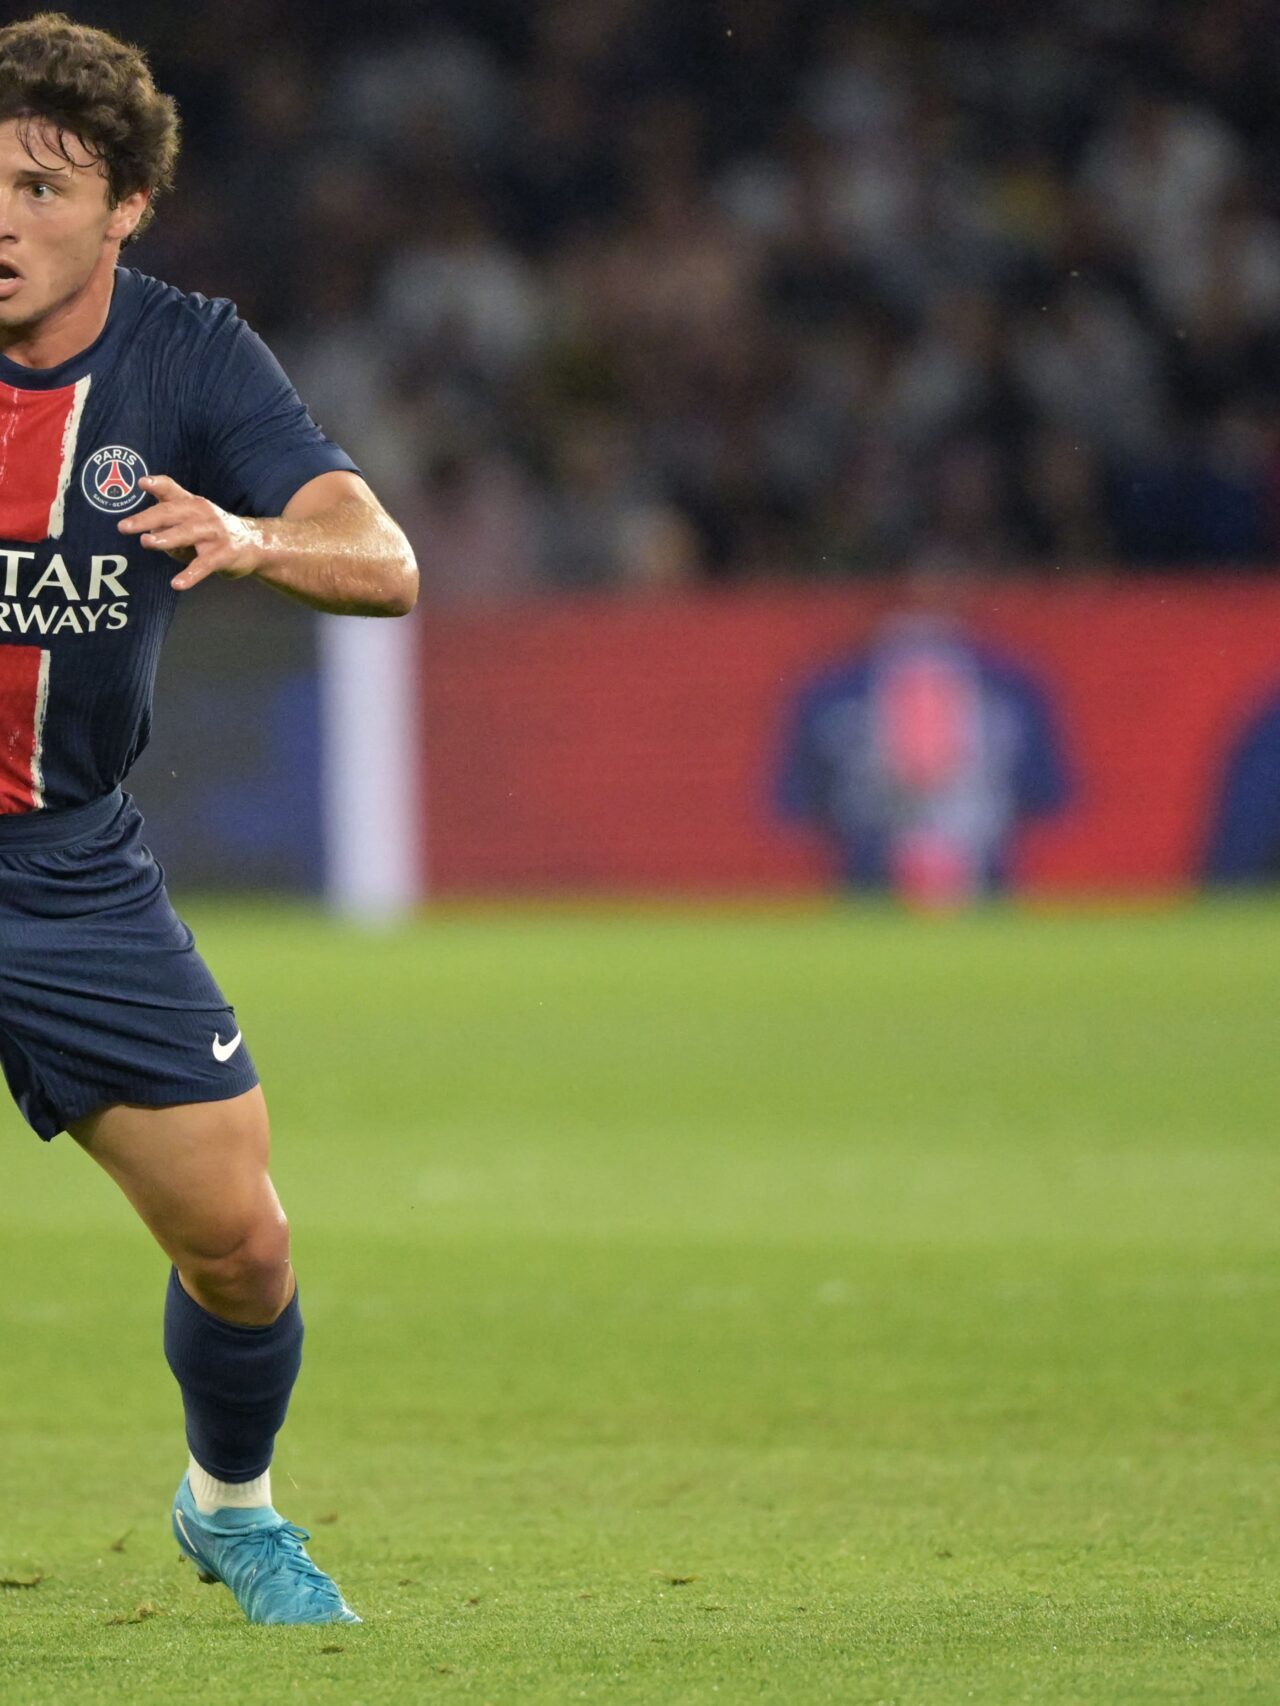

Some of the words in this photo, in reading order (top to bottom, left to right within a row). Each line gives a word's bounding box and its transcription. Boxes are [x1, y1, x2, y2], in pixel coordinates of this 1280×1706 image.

[93, 449, 137, 466] PARIS
[93, 493, 109, 506] SAINT
[112, 494, 136, 507] GERMAIN
